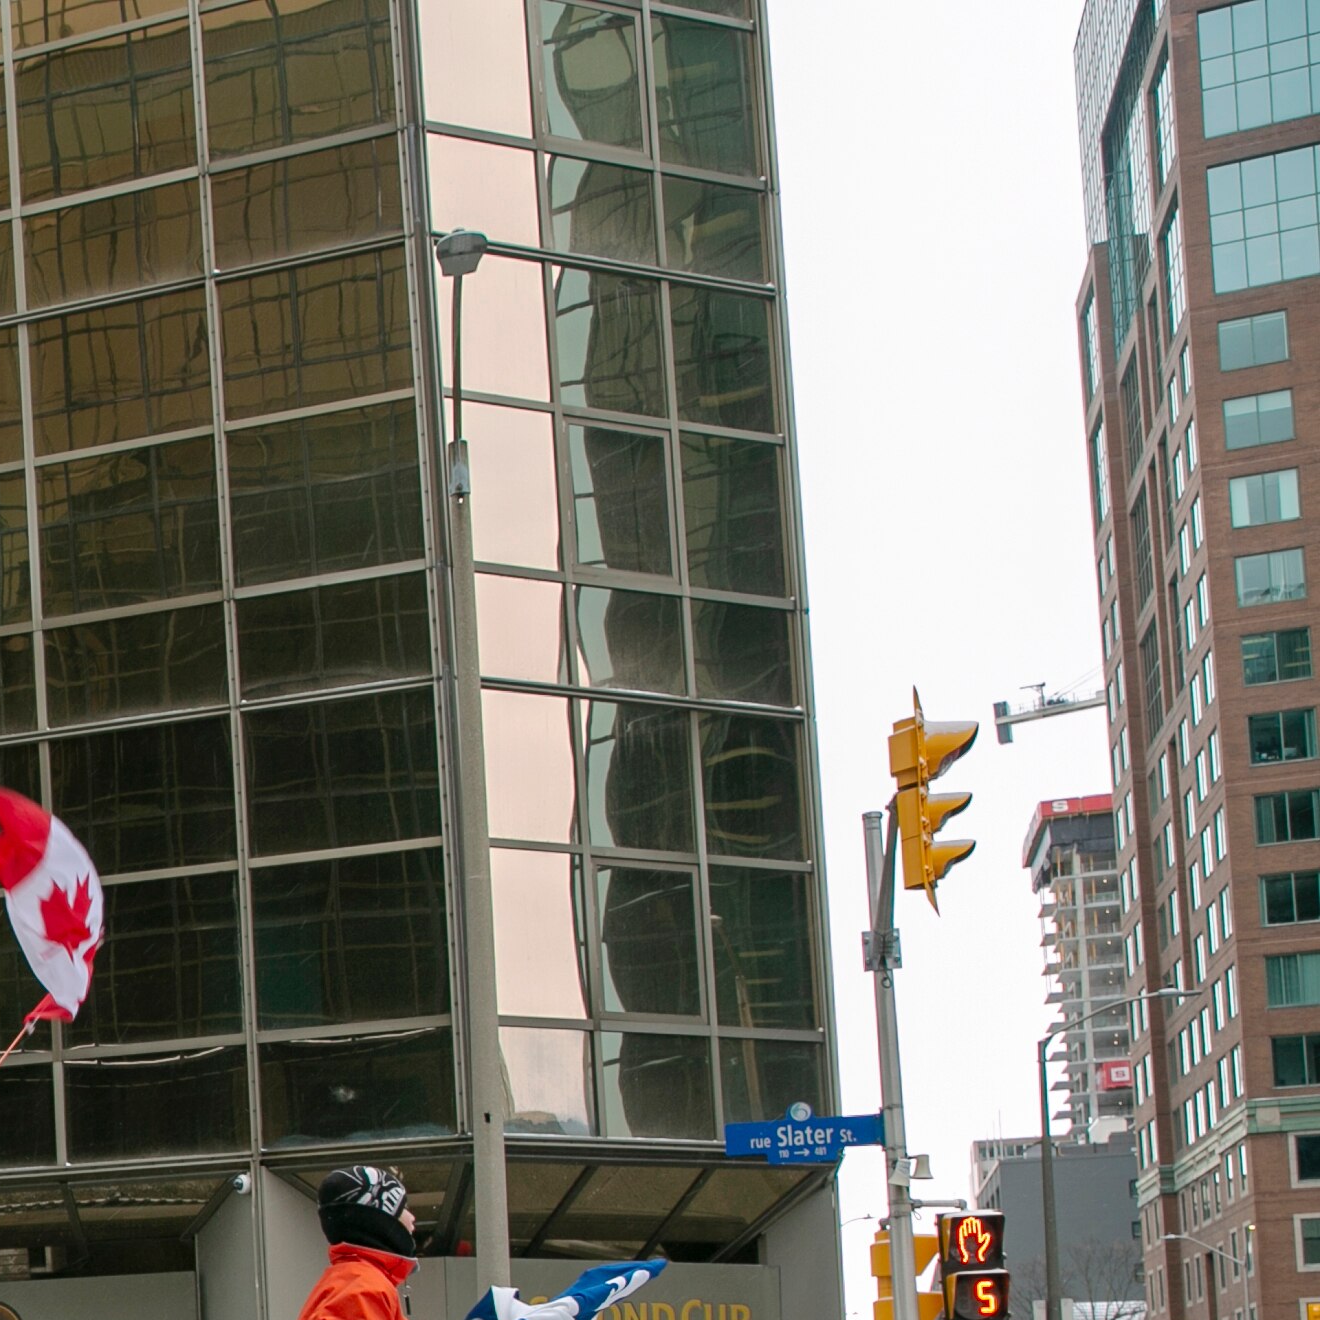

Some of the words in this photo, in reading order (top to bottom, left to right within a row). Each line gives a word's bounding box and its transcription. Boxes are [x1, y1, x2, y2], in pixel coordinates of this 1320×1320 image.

[750, 1137, 771, 1149] rue
[776, 1124, 834, 1148] Slater
[839, 1128, 858, 1143] St.
[976, 1280, 997, 1315] 5
